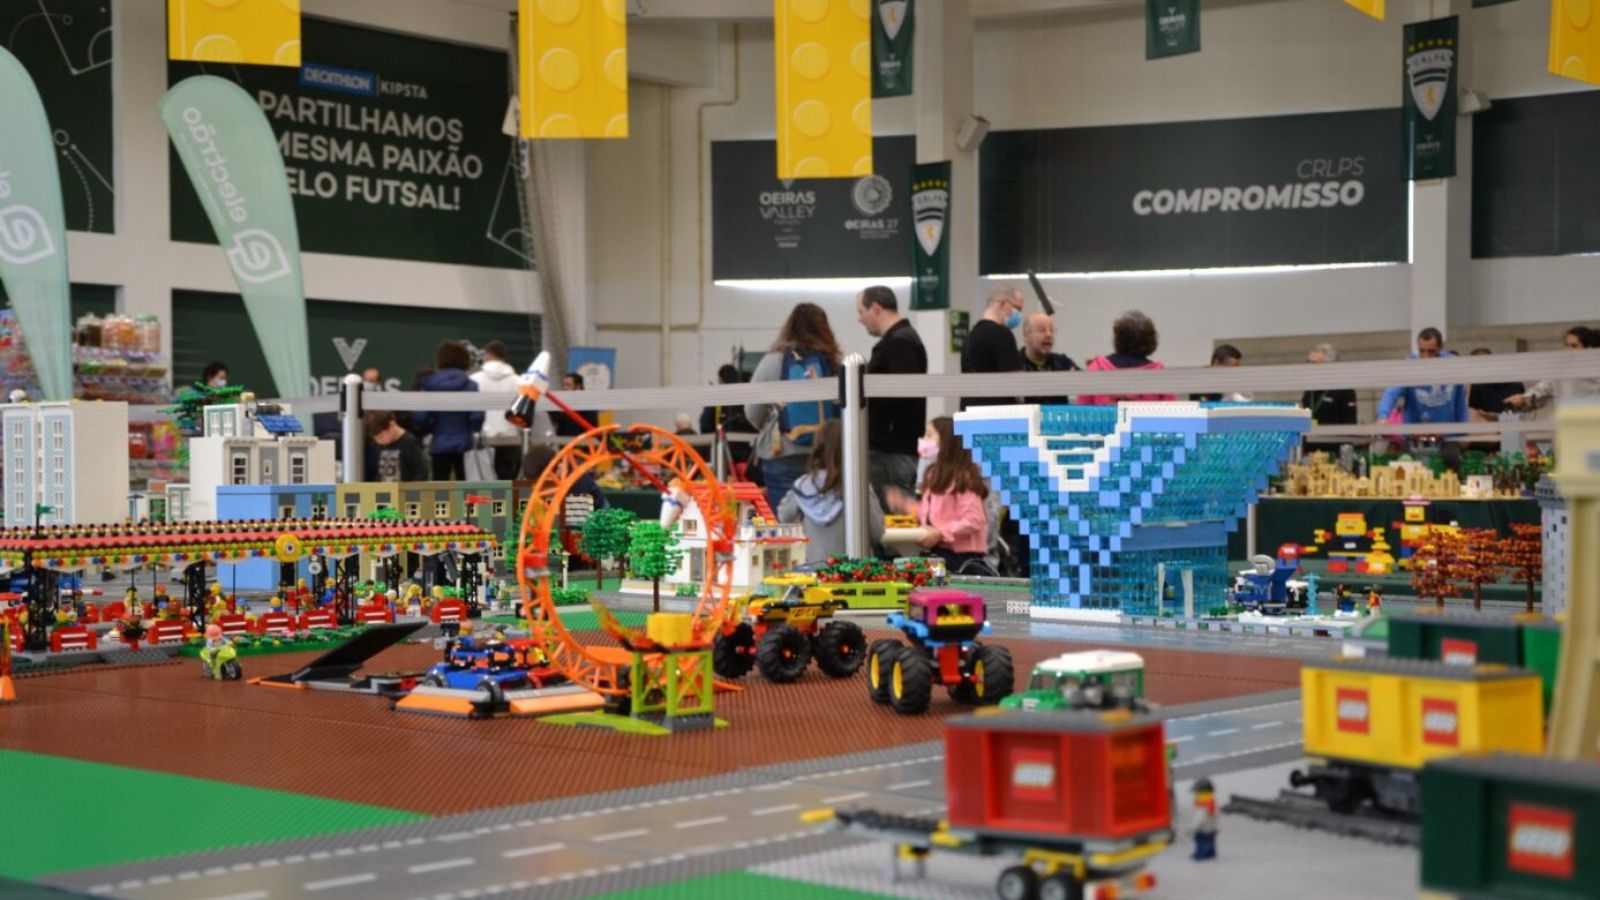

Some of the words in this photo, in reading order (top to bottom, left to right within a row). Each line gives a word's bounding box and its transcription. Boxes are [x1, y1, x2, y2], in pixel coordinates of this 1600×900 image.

[304, 68, 370, 90] DECATHLON
[380, 80, 428, 98] KIPSTA
[258, 89, 464, 144] PARTILHAMOS
[382, 144, 483, 179] PAIXÃO
[1296, 156, 1365, 179] CRLPS
[284, 166, 338, 198] ELO
[346, 175, 461, 211] FUTSAL!
[759, 191, 816, 205] OEIRAS
[1132, 179, 1365, 215] COMPROMISSO
[759, 205, 817, 219] VALLEY
[887, 218, 899, 230] 27
